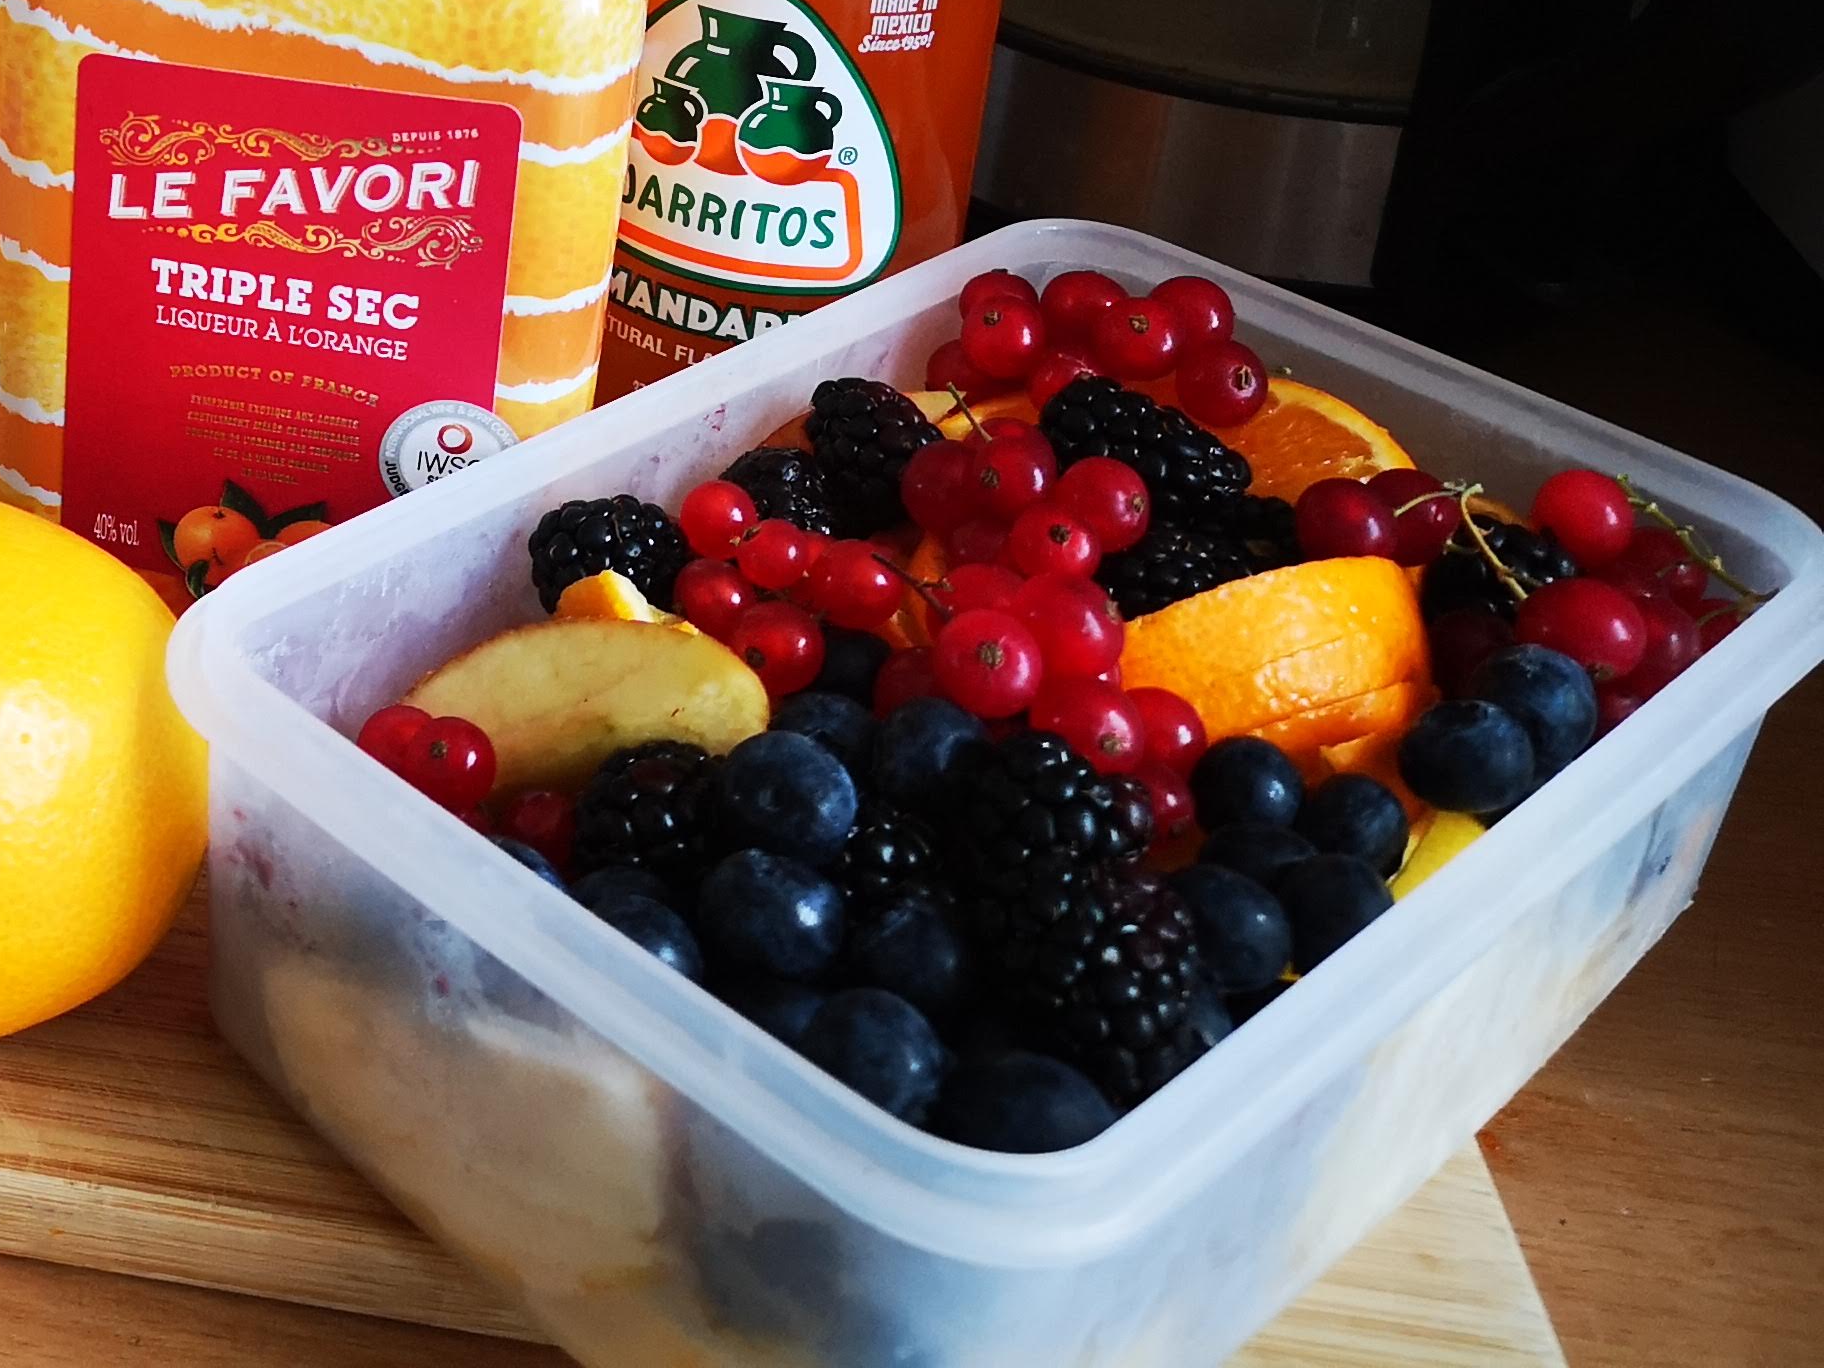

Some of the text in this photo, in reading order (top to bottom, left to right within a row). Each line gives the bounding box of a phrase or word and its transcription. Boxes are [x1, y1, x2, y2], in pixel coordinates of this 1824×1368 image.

[871, 12, 933, 35] MEXICO
[392, 130, 442, 143] DEPUIS
[108, 159, 480, 220] LE FAVORI
[150, 257, 421, 331] TRIPLE SEC
[155, 304, 409, 362] LIQUEUR À L'ORANGE
[605, 314, 668, 358] TURAL
[169, 364, 380, 407] PRODUCT OF FRANCE
[93, 513, 118, 542] 40%
